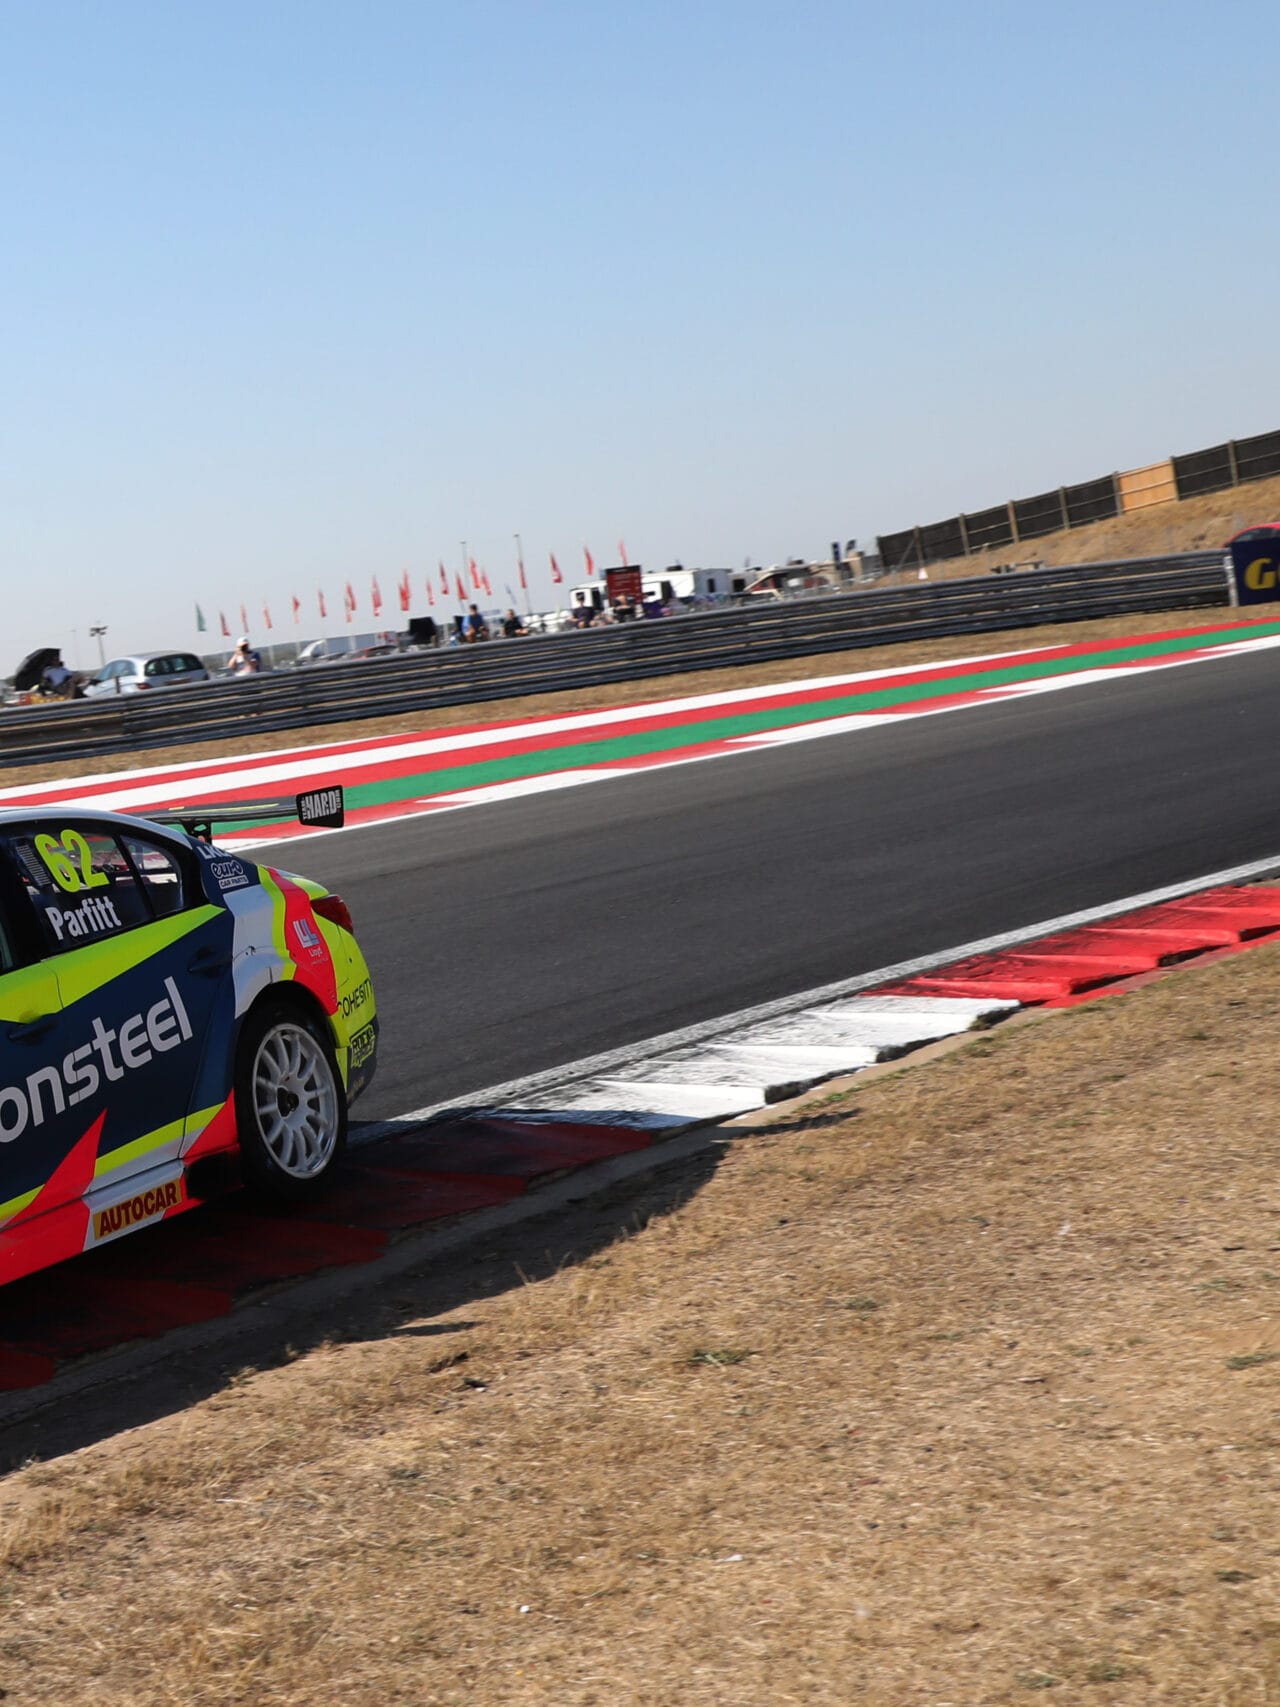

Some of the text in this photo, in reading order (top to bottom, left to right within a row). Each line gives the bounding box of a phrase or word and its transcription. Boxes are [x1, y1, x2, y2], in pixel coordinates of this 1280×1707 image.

[1244, 557, 1280, 590] G
[305, 791, 337, 819] HARD
[34, 829, 110, 893] 62
[45, 896, 122, 940] Parfitt
[99, 1183, 178, 1238] AUTOCAR
